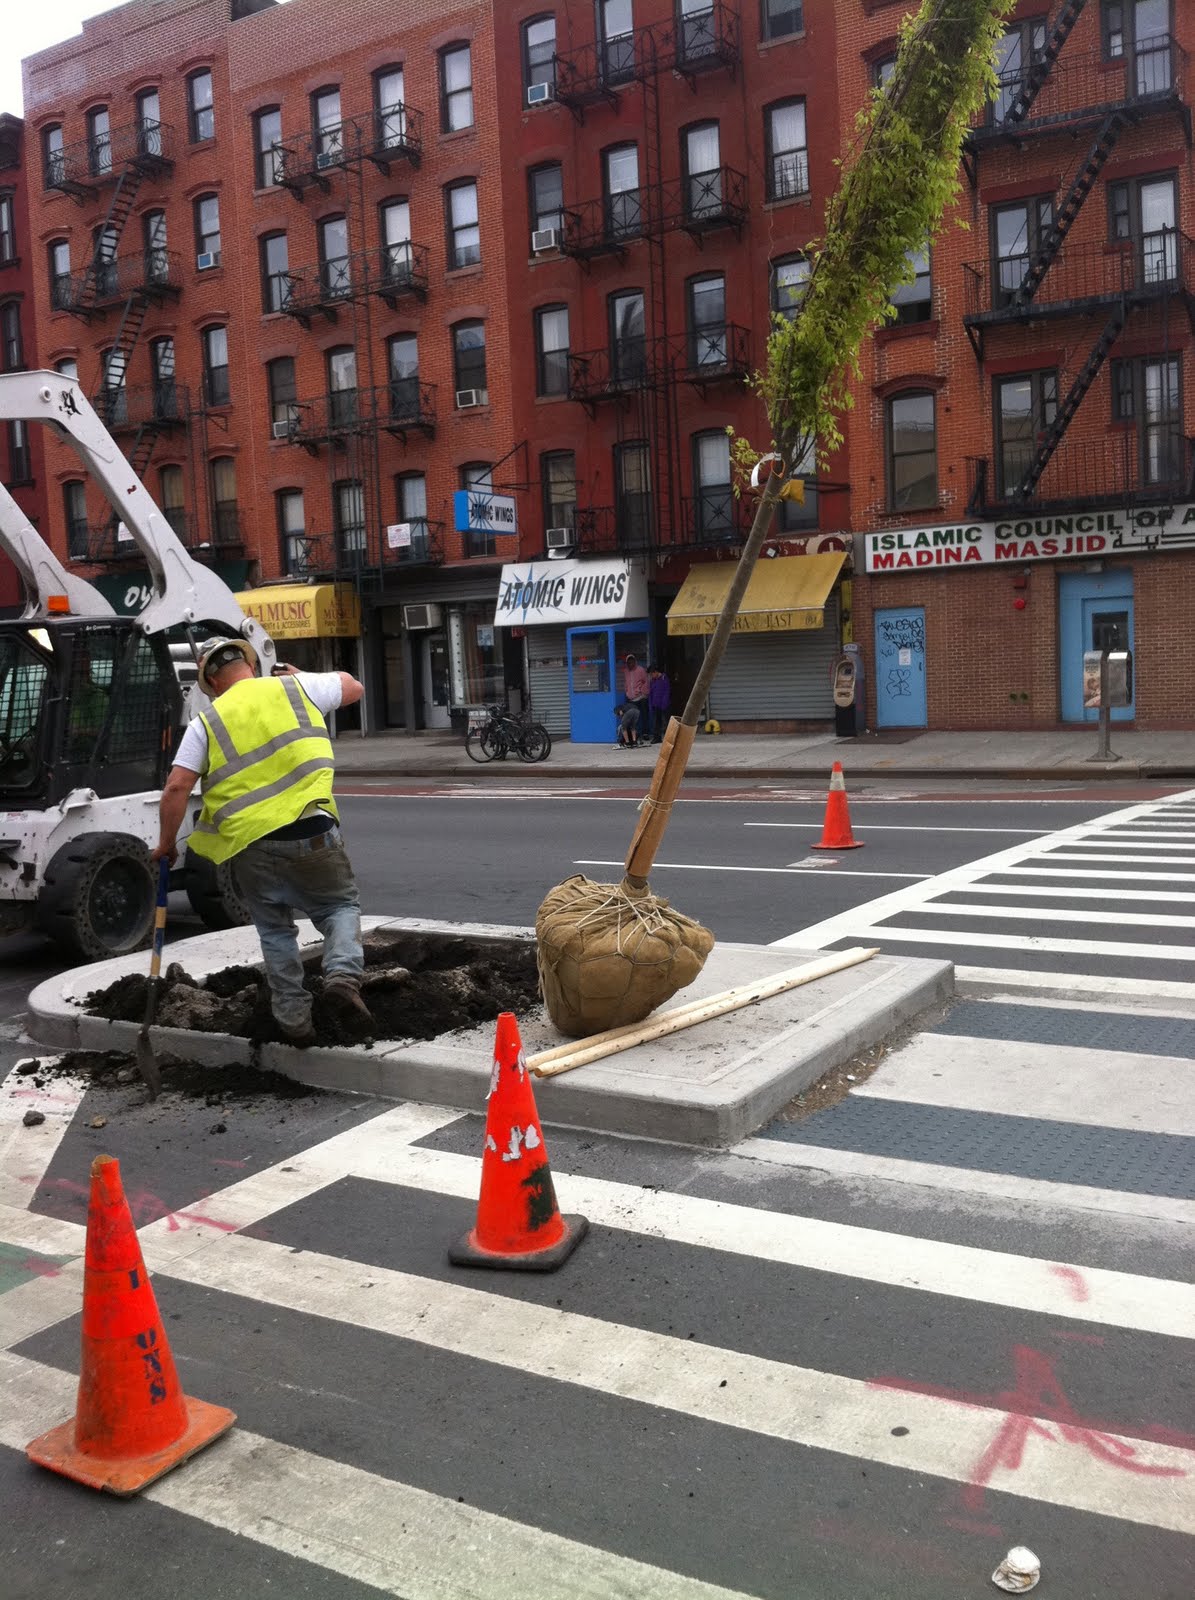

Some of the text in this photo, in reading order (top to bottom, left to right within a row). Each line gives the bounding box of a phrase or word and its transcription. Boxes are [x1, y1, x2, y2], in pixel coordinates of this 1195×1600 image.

[471, 503, 514, 523] ATOMIC WINGS
[872, 527, 982, 551] ISLAMIC
[995, 514, 1123, 540] COUNCIL
[1135, 508, 1175, 528] OF
[872, 534, 1106, 570] MADINA MASJID
[499, 572, 627, 611] ATOMIC WINGS
[266, 600, 312, 621] MUSIC
[704, 614, 750, 631] SARA
